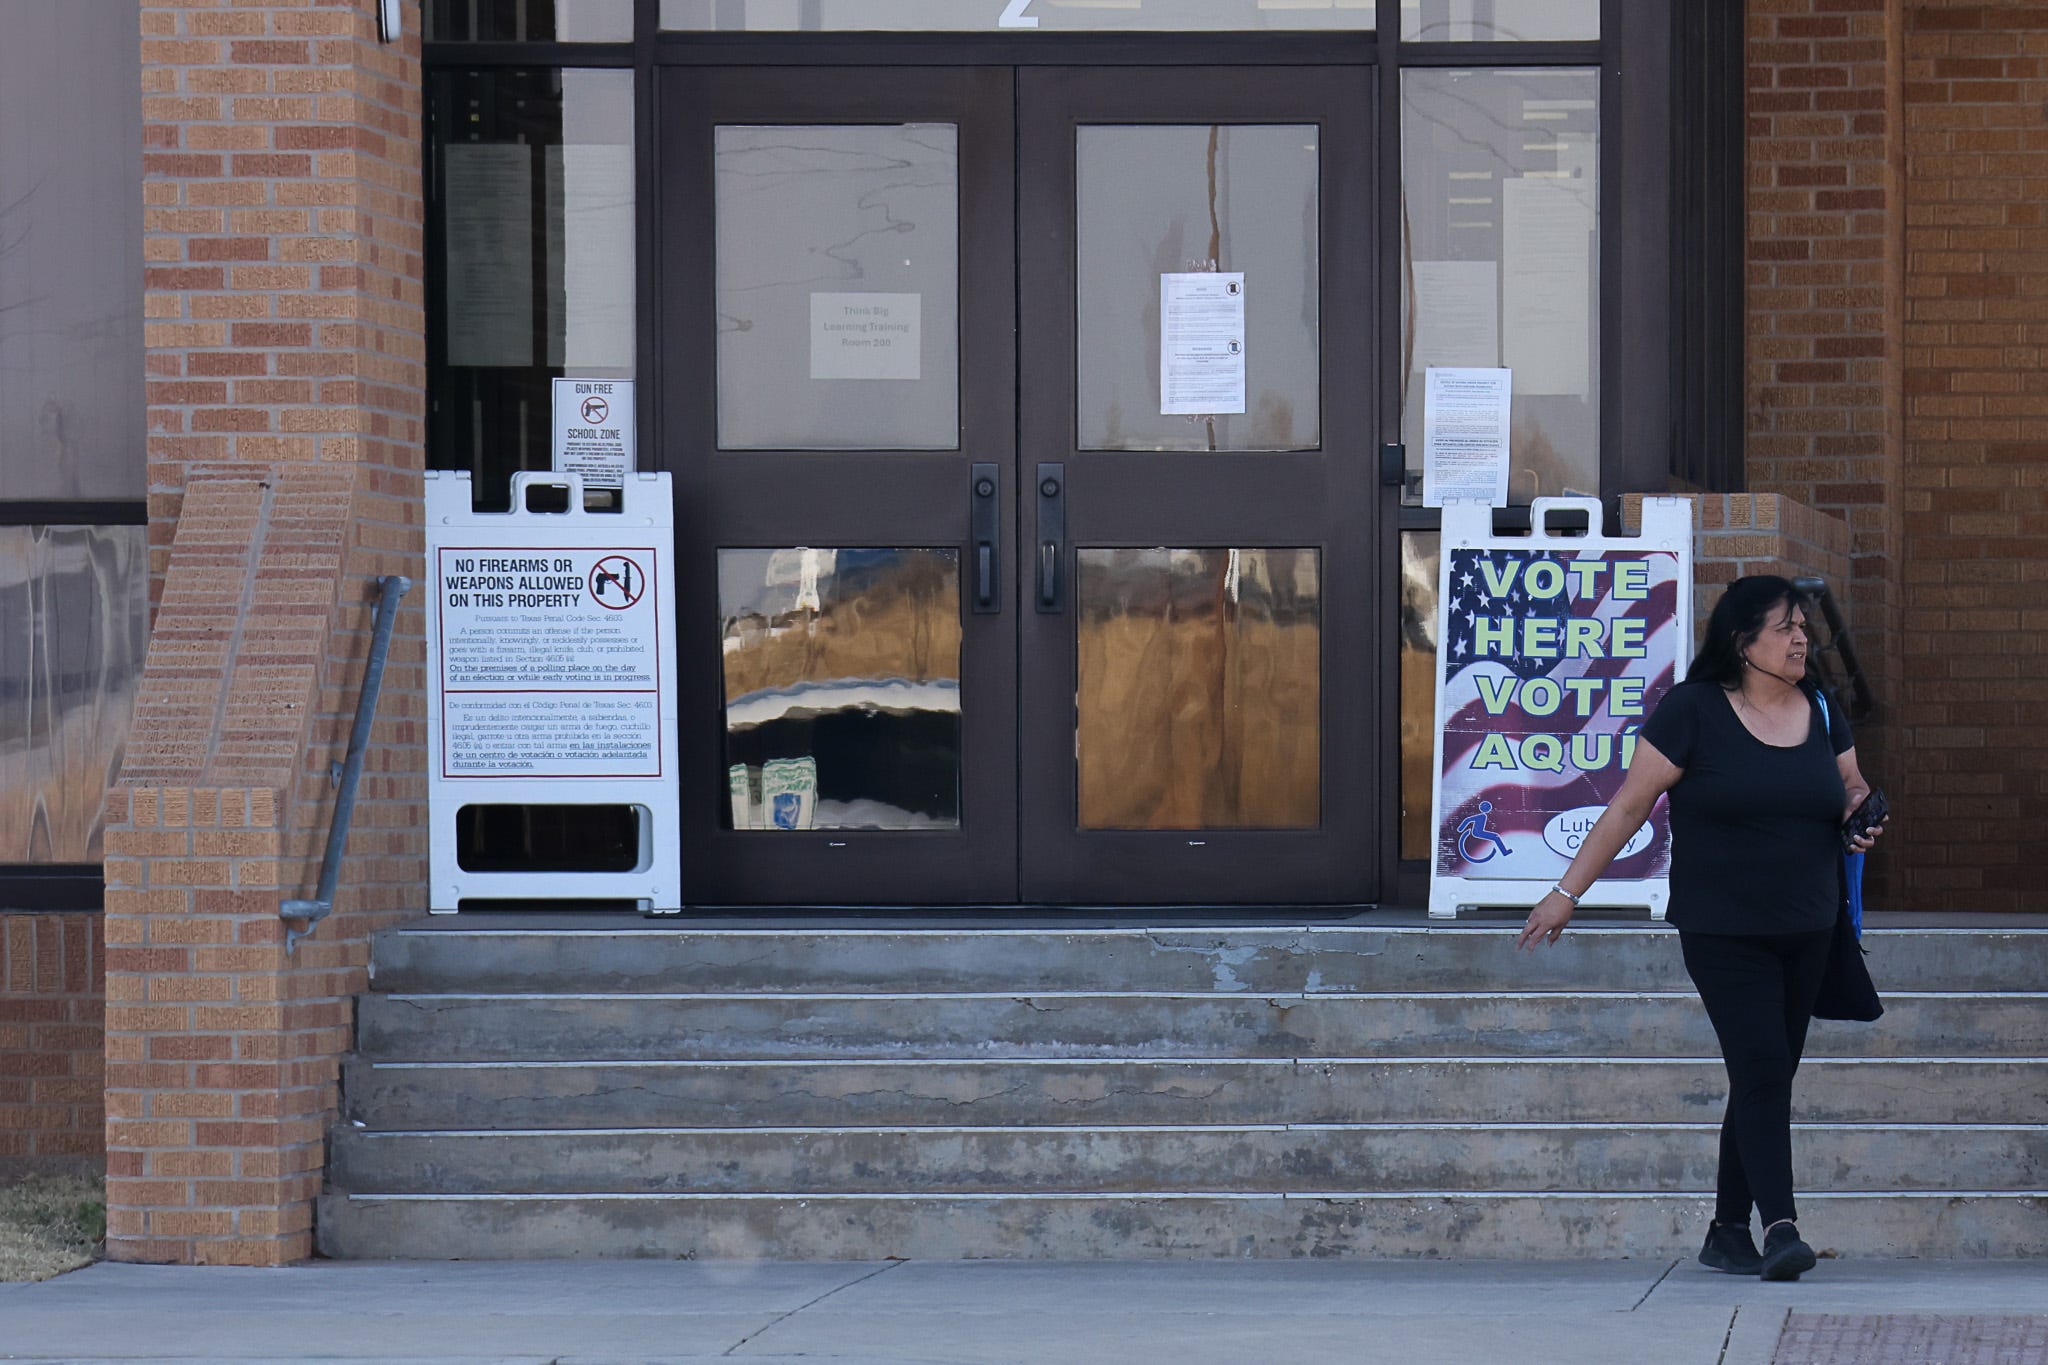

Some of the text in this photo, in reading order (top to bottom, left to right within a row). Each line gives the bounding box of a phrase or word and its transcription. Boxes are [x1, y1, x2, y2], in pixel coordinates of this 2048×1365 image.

[575, 383, 613, 395] GUN FREE
[567, 428, 621, 440] SCHOOL ZONE
[455, 558, 573, 573] NO FIREARMS OR
[446, 576, 584, 590] WEAPONS ALLOWED
[1479, 558, 1650, 601] VOTE
[449, 593, 581, 608] ON THIS PROPERTY
[511, 615, 518, 623] to
[460, 627, 467, 635] A
[469, 628, 494, 636] person
[581, 627, 594, 635] the
[1473, 616, 1648, 659] HERE
[449, 647, 467, 655] goes
[469, 646, 487, 654] with
[529, 646, 552, 655] illegal
[606, 646, 644, 655] prohibited
[449, 656, 479, 665] weapon
[482, 655, 503, 663] listed
[505, 655, 513, 663] in
[516, 655, 543, 663] Section
[449, 664, 636, 674] On the premises of a polling place on the day
[542, 674, 562, 683] early
[565, 674, 591, 683] voting
[1473, 675, 1646, 718] VOTE
[1469, 723, 1643, 774] AQUÍ
[452, 751, 463, 759] de
[479, 751, 505, 759] centro
[508, 751, 518, 759] de
[520, 751, 555, 759] votación
[565, 751, 599, 759] votación
[602, 751, 648, 759] adelantada
[453, 760, 486, 768] durante
[488, 760, 496, 768] la
